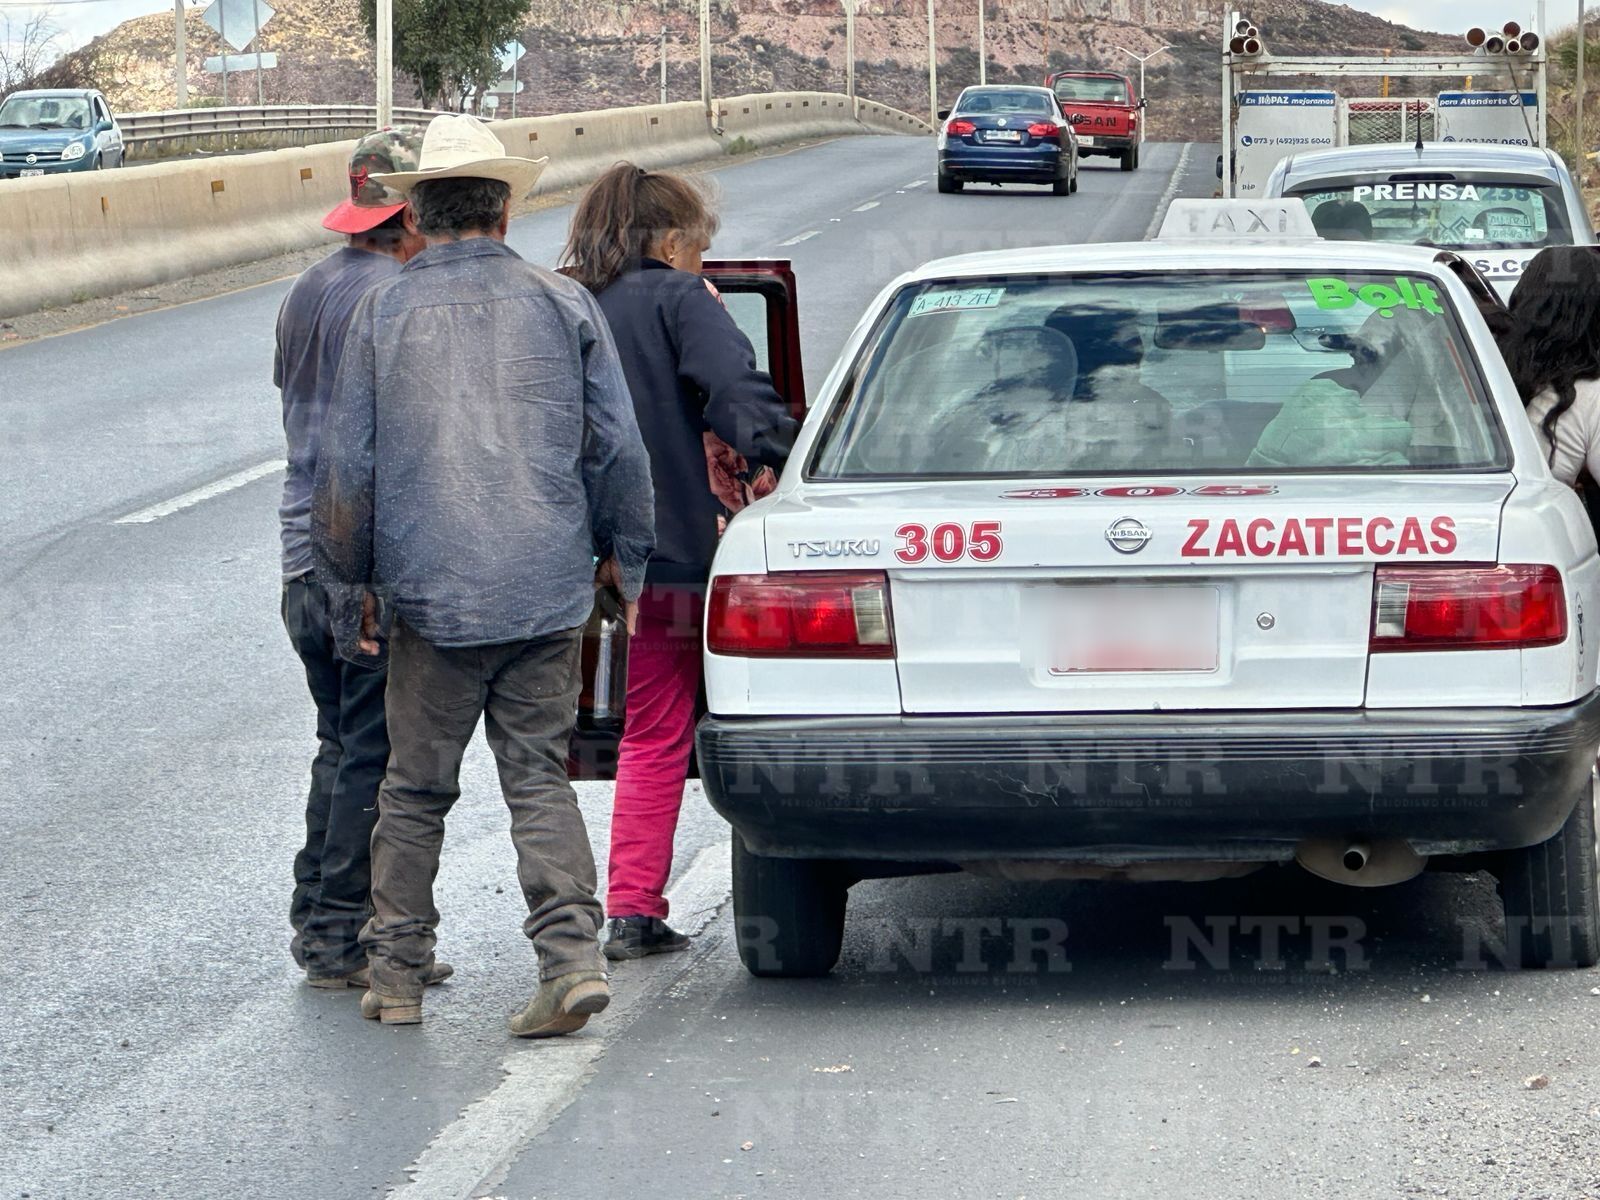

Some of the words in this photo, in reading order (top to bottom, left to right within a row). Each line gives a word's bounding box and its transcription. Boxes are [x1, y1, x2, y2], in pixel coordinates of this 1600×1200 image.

[1353, 184, 1481, 202] PRENSA
[1181, 208, 1288, 233] TAXI
[1305, 277, 1445, 318] Bolt
[894, 520, 1004, 564] 305
[1109, 529, 1148, 538] NISSAN
[1181, 516, 1458, 558] ZACATECAS
[787, 538, 880, 558] TSURU
